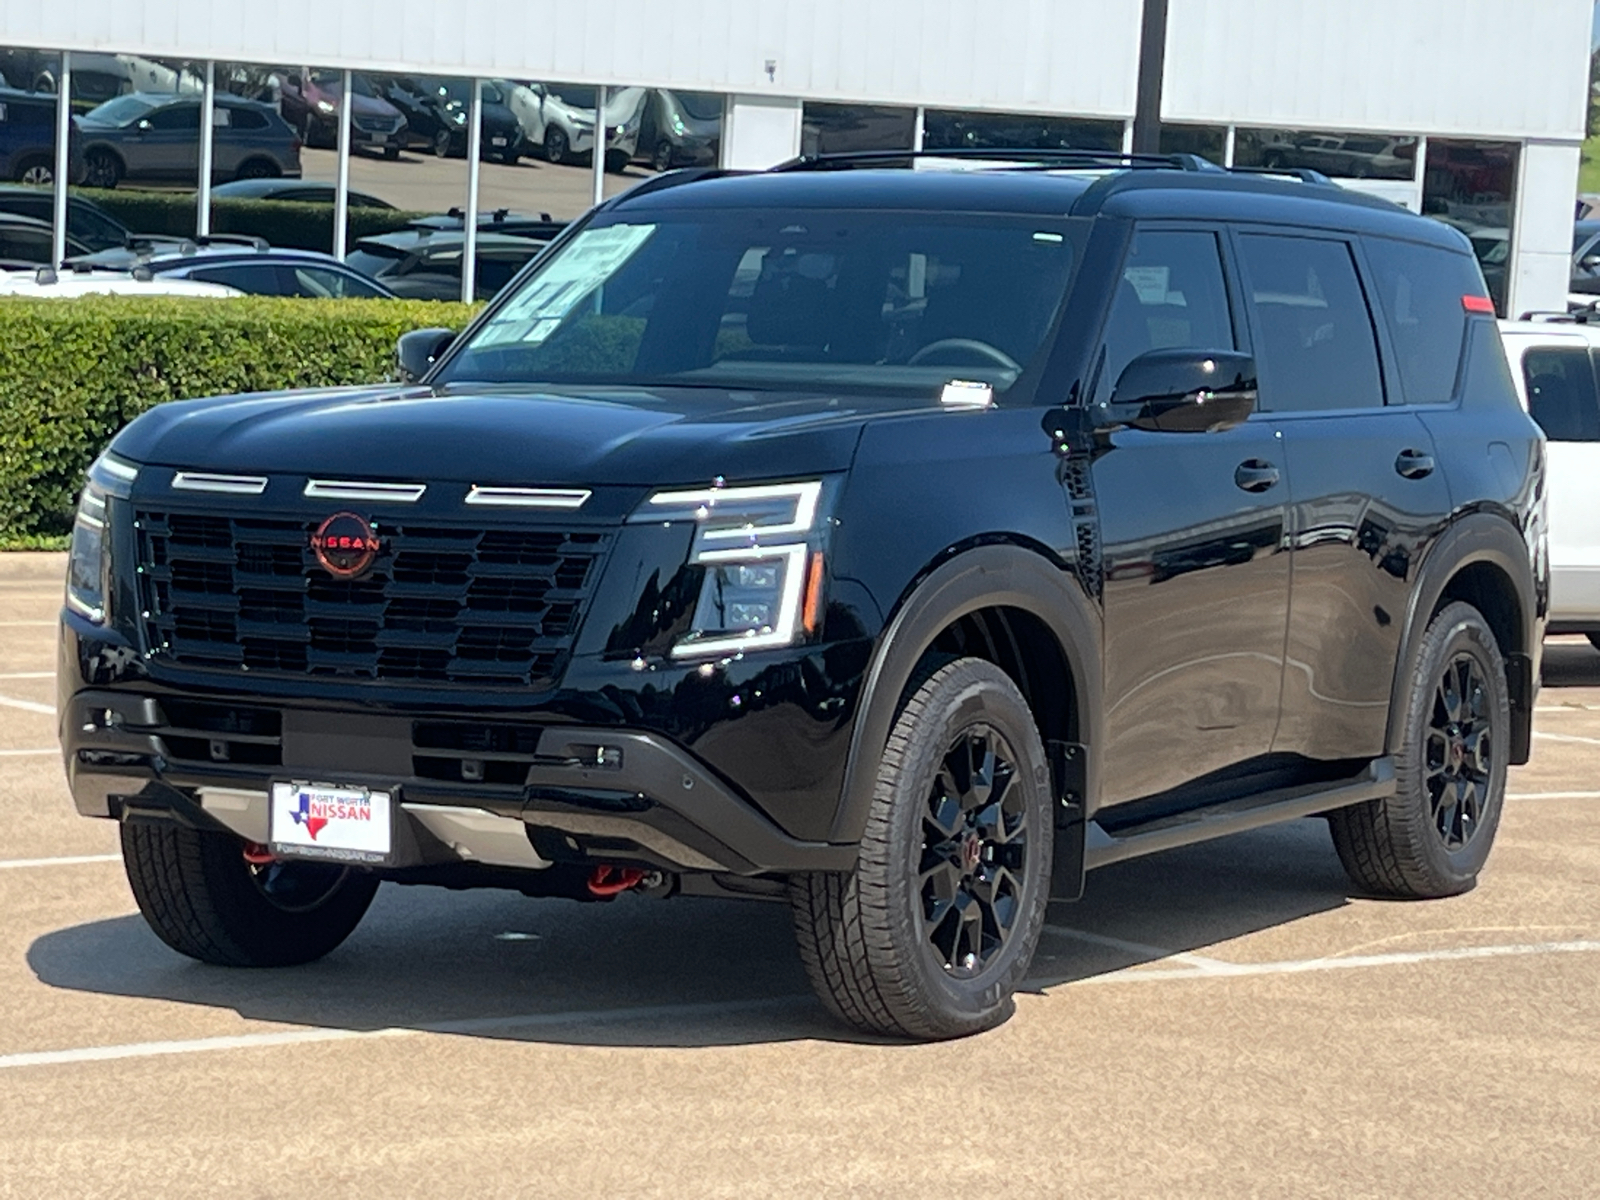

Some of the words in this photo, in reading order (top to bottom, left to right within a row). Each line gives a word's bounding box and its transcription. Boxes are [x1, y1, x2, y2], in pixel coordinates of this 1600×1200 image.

[310, 793, 334, 803] FORT
[337, 796, 371, 806] WORTH
[311, 803, 371, 821] NISSAN
